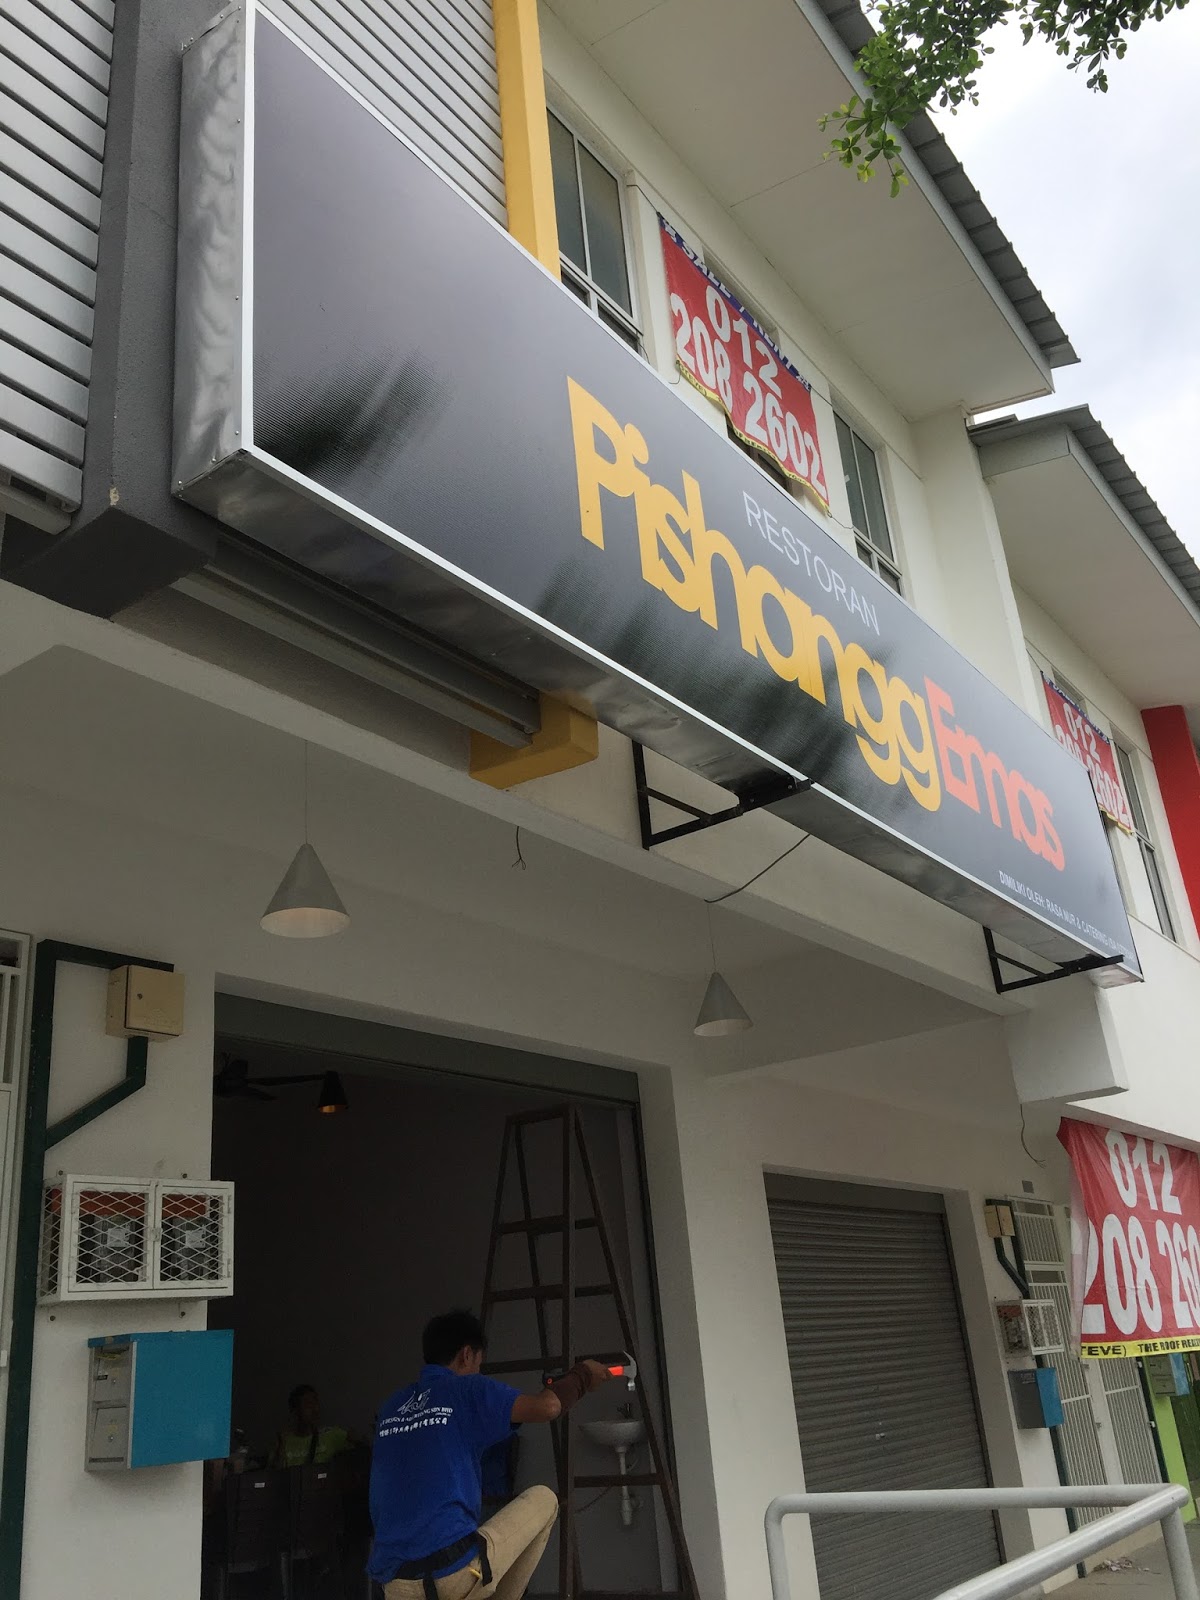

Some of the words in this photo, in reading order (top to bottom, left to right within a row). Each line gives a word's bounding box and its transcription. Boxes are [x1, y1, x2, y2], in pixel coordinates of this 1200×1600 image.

[705, 285, 782, 399] 012
[670, 292, 733, 414] 208
[743, 370, 829, 502] 2602
[742, 490, 880, 635] RESTORAN
[1063, 702, 1101, 764] 012
[1105, 1129, 1182, 1215] 012
[1138, 1343, 1159, 1353] THE
[1160, 1339, 1180, 1351] ROOF
